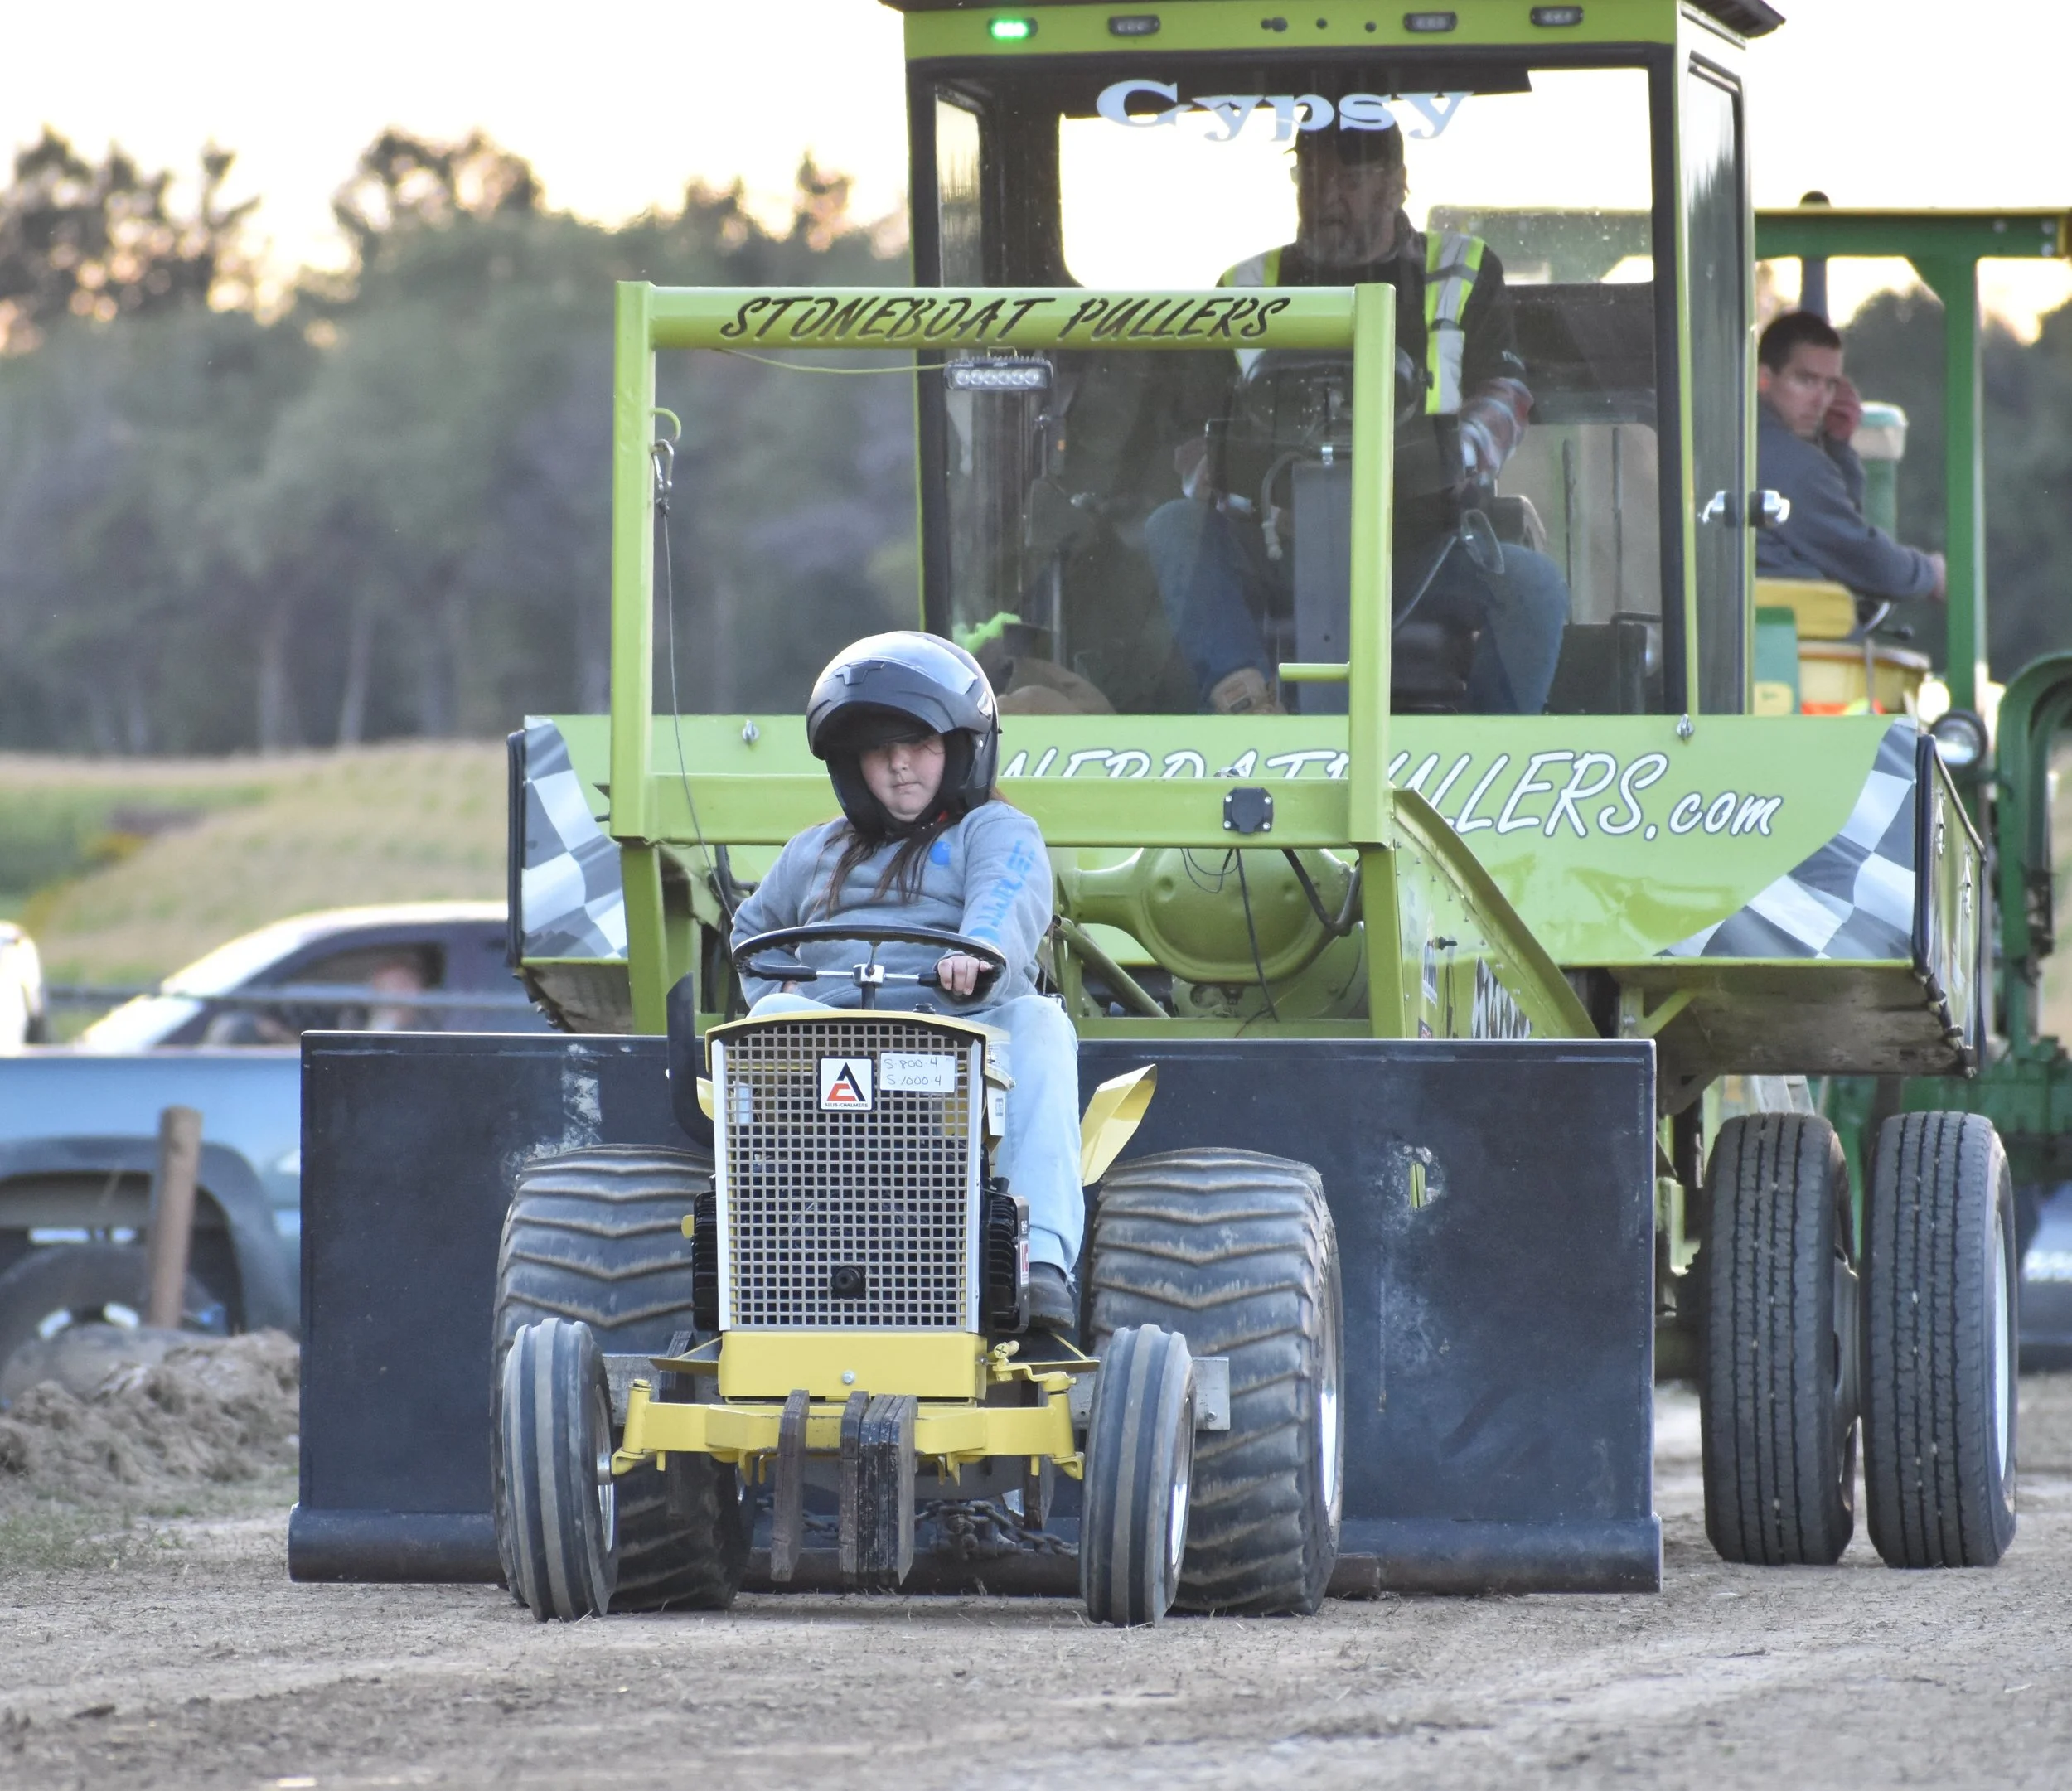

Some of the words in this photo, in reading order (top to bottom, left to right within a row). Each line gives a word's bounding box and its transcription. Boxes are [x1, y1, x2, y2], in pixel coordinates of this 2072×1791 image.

[1096, 79, 1474, 142] Gypsy
[719, 295, 1058, 341] STONEBOAT
[1055, 297, 1291, 341] PULLERS
